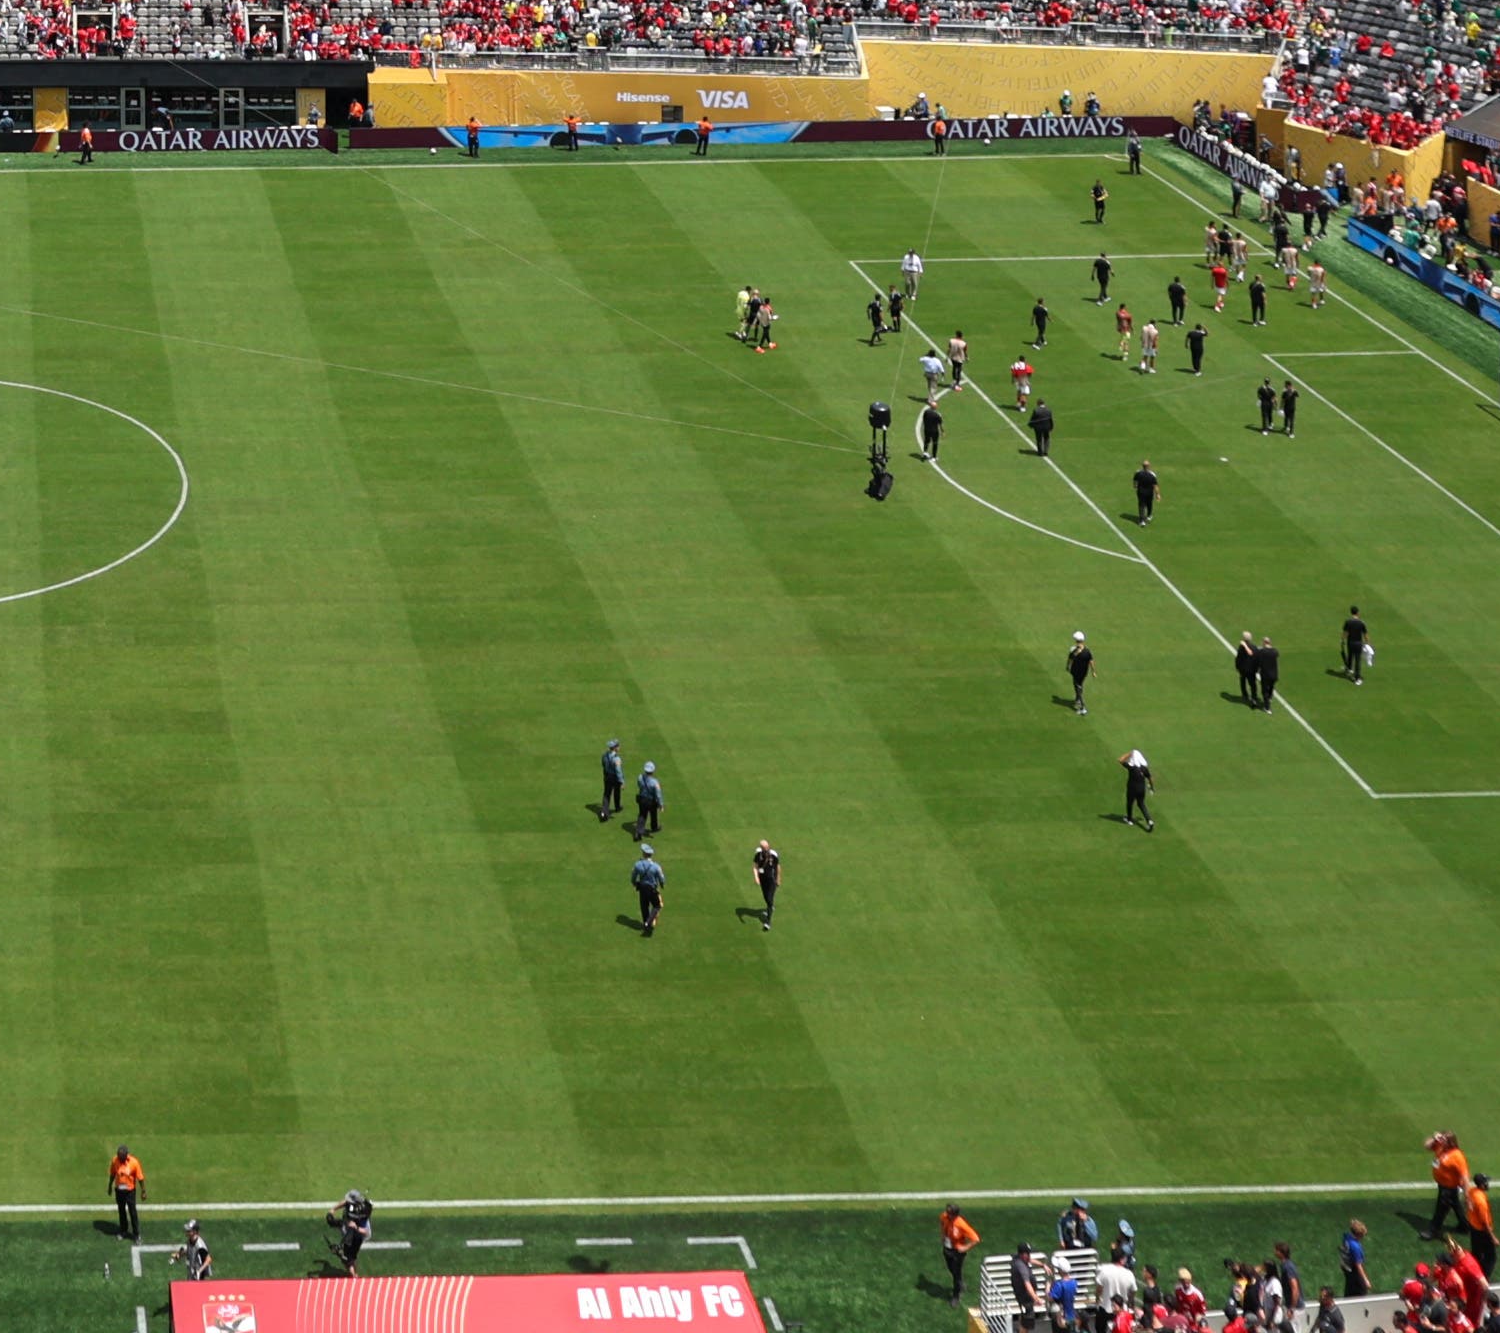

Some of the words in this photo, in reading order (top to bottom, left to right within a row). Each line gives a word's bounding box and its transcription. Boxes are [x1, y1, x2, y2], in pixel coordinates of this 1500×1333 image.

[616, 91, 670, 103] Hisense
[696, 89, 749, 109] VISA
[1020, 117, 1124, 137] AIRWAYS
[119, 129, 203, 153] QATAR
[213, 128, 319, 150] AIRWAYS
[1179, 125, 1221, 167] QATAR
[577, 1286, 612, 1320] Al
[619, 1285, 693, 1322] Ahly
[701, 1285, 745, 1318] FC
